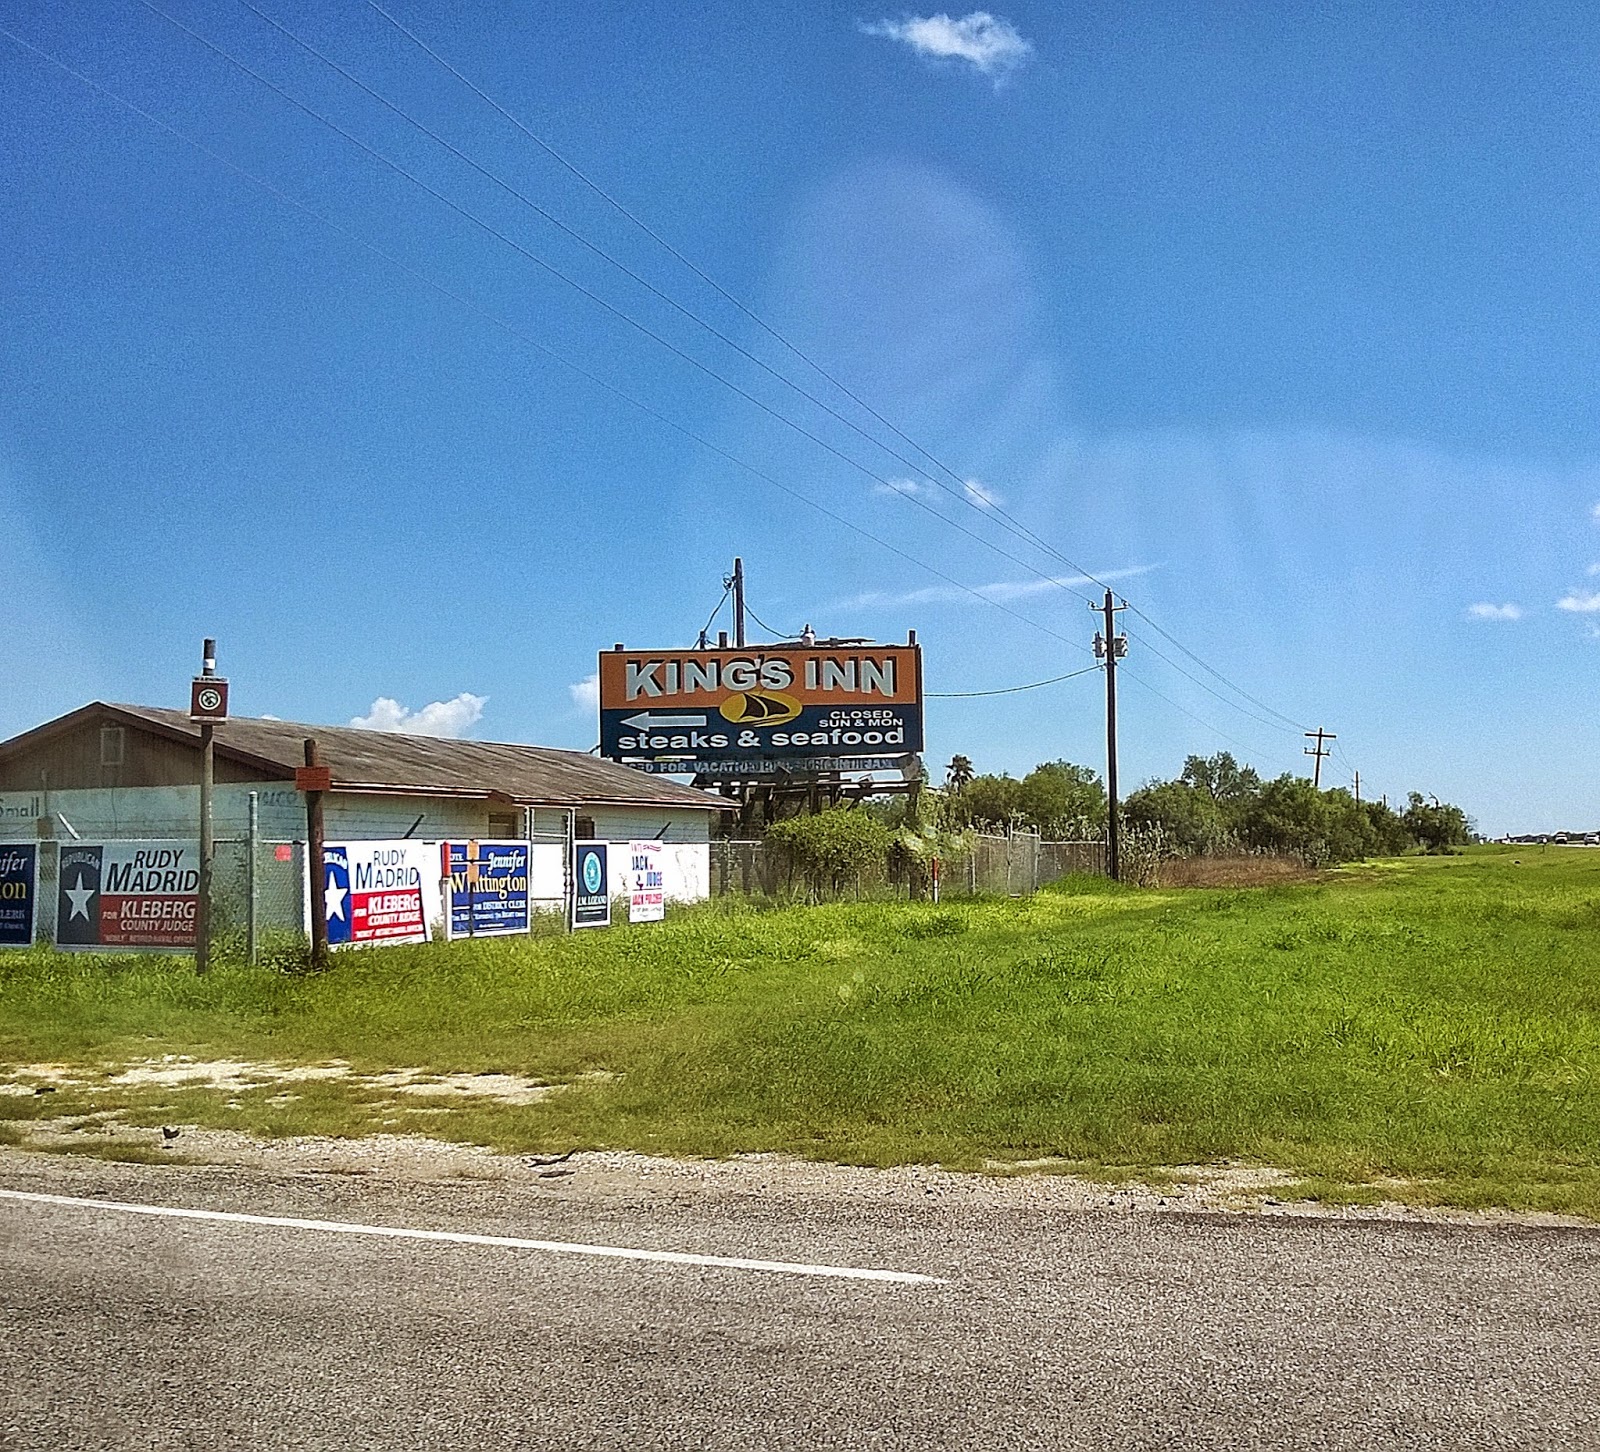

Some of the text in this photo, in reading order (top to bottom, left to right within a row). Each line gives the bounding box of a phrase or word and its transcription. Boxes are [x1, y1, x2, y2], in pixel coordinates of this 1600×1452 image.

[625, 653, 898, 701] KING'S INN
[818, 717, 904, 728] SUN & MON
[830, 709, 894, 720] CLOSED
[617, 727, 905, 750] steaks & seafood
[660, 762, 687, 773] FOR
[133, 849, 185, 869] RUDY
[373, 849, 407, 867] RUDY
[487, 849, 527, 876] Jennifer
[632, 855, 649, 871] JACK
[105, 862, 199, 893] MADRID
[355, 862, 420, 890] MADRID
[0, 881, 27, 900] on
[102, 900, 197, 921] FOR KLEBERG
[368, 893, 420, 915] KLEBERG
[120, 919, 195, 932] COUNTY JUDGE
[367, 911, 421, 926] COUNTY JUDGE
